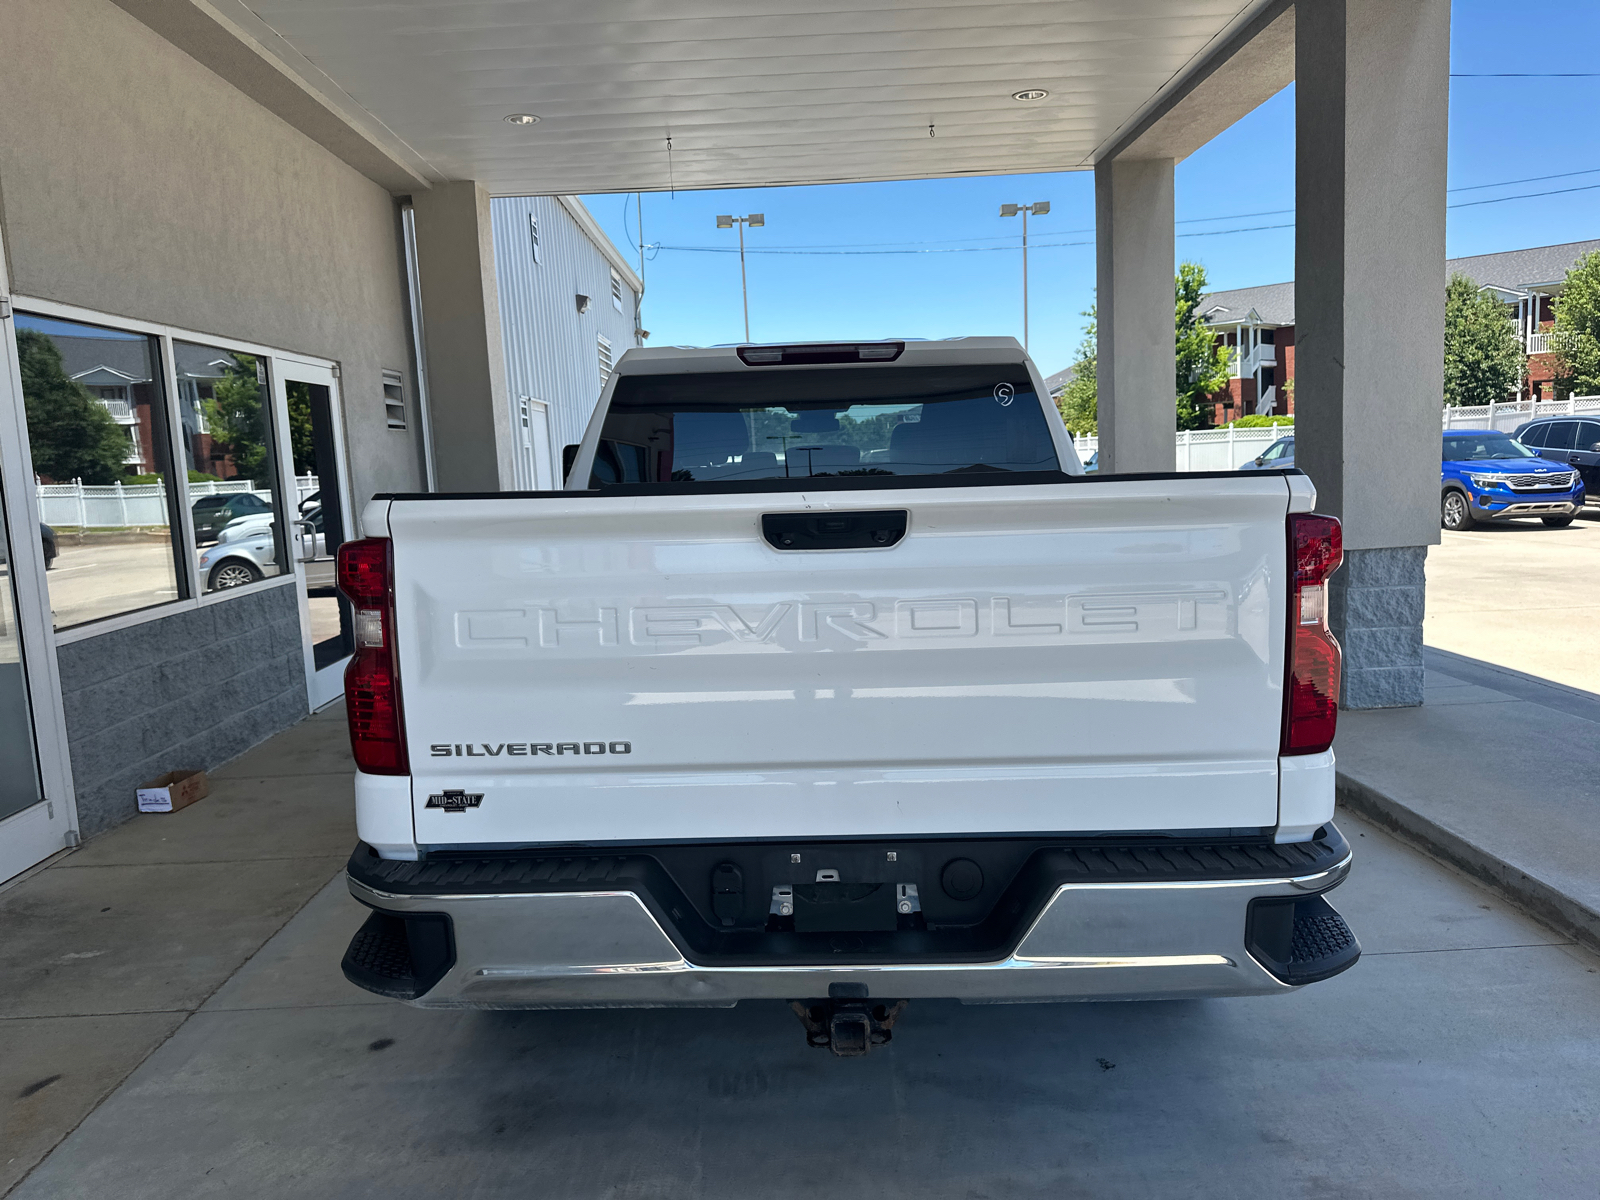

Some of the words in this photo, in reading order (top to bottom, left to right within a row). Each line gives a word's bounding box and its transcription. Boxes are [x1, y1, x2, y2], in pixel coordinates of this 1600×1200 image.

[454, 590, 1228, 648] CHEVROLET
[430, 741, 632, 757] SILVERADO
[431, 795, 478, 805] MID-STATE
